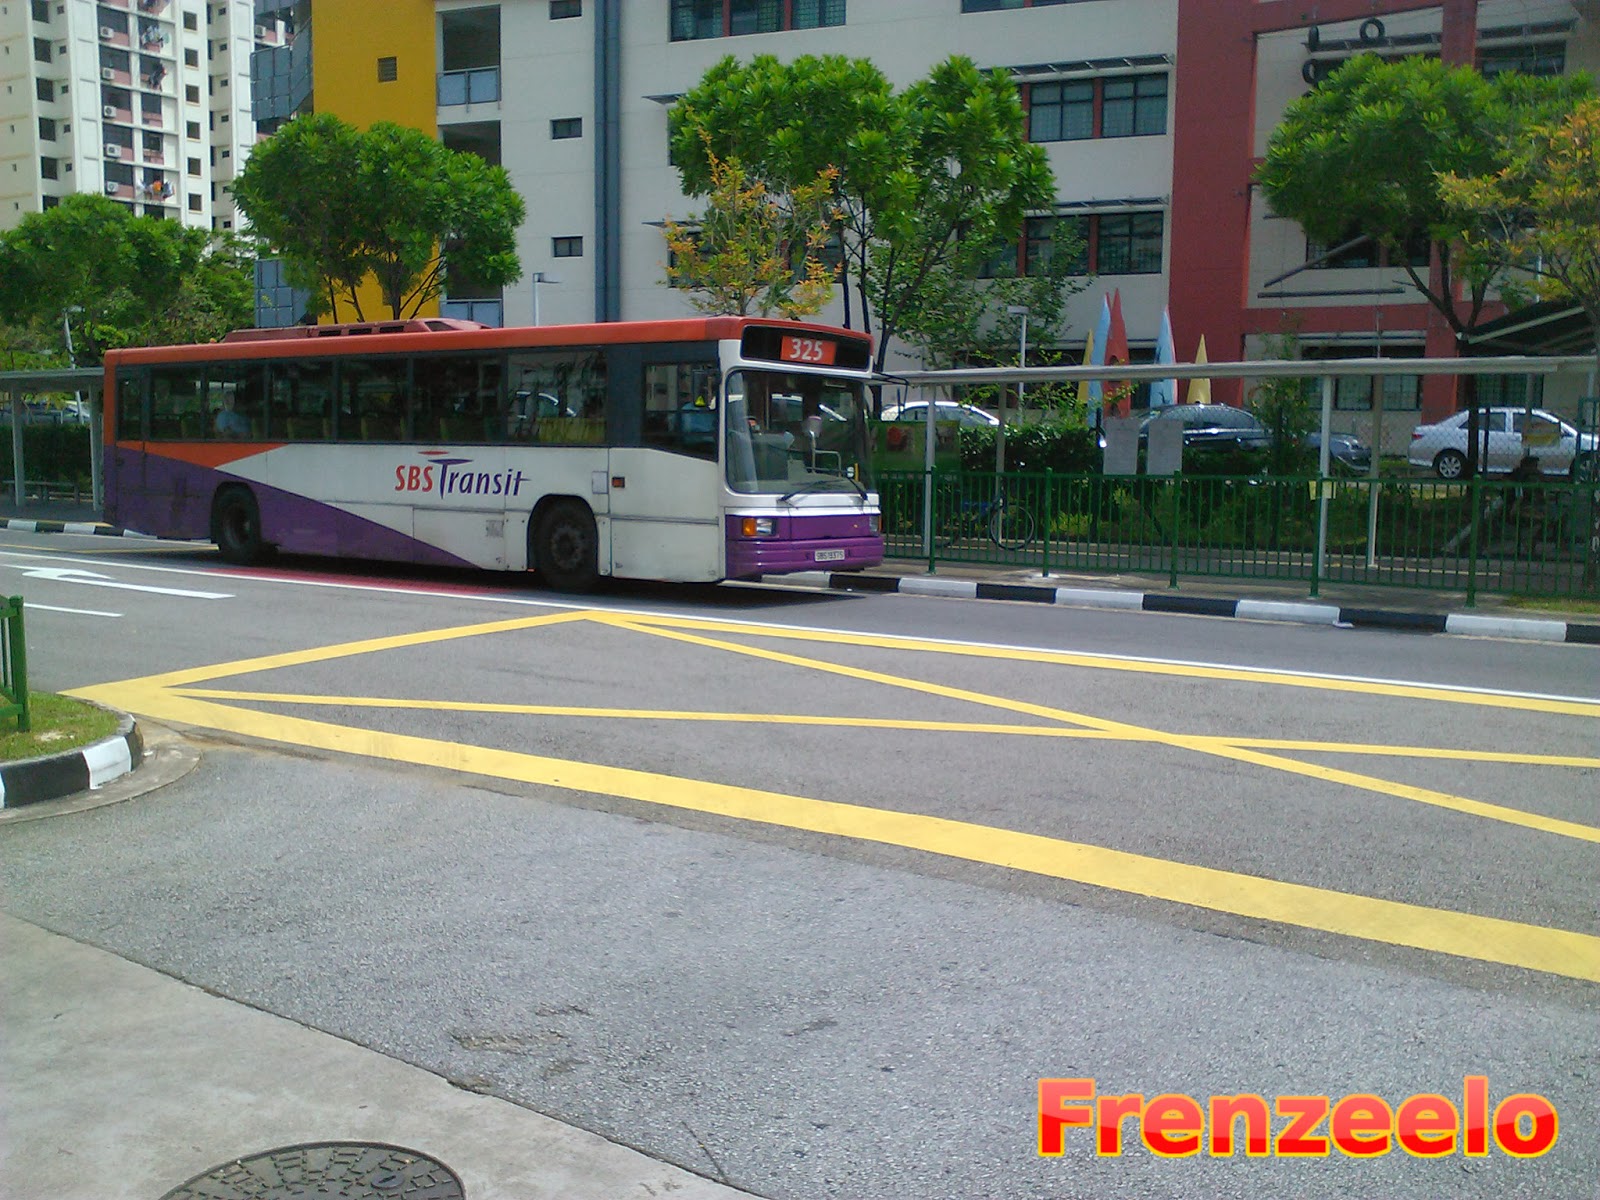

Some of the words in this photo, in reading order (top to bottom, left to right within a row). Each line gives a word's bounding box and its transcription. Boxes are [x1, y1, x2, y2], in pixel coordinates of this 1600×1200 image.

[790, 338, 823, 361] 325
[394, 464, 434, 492] SBS
[427, 458, 532, 500] Transit
